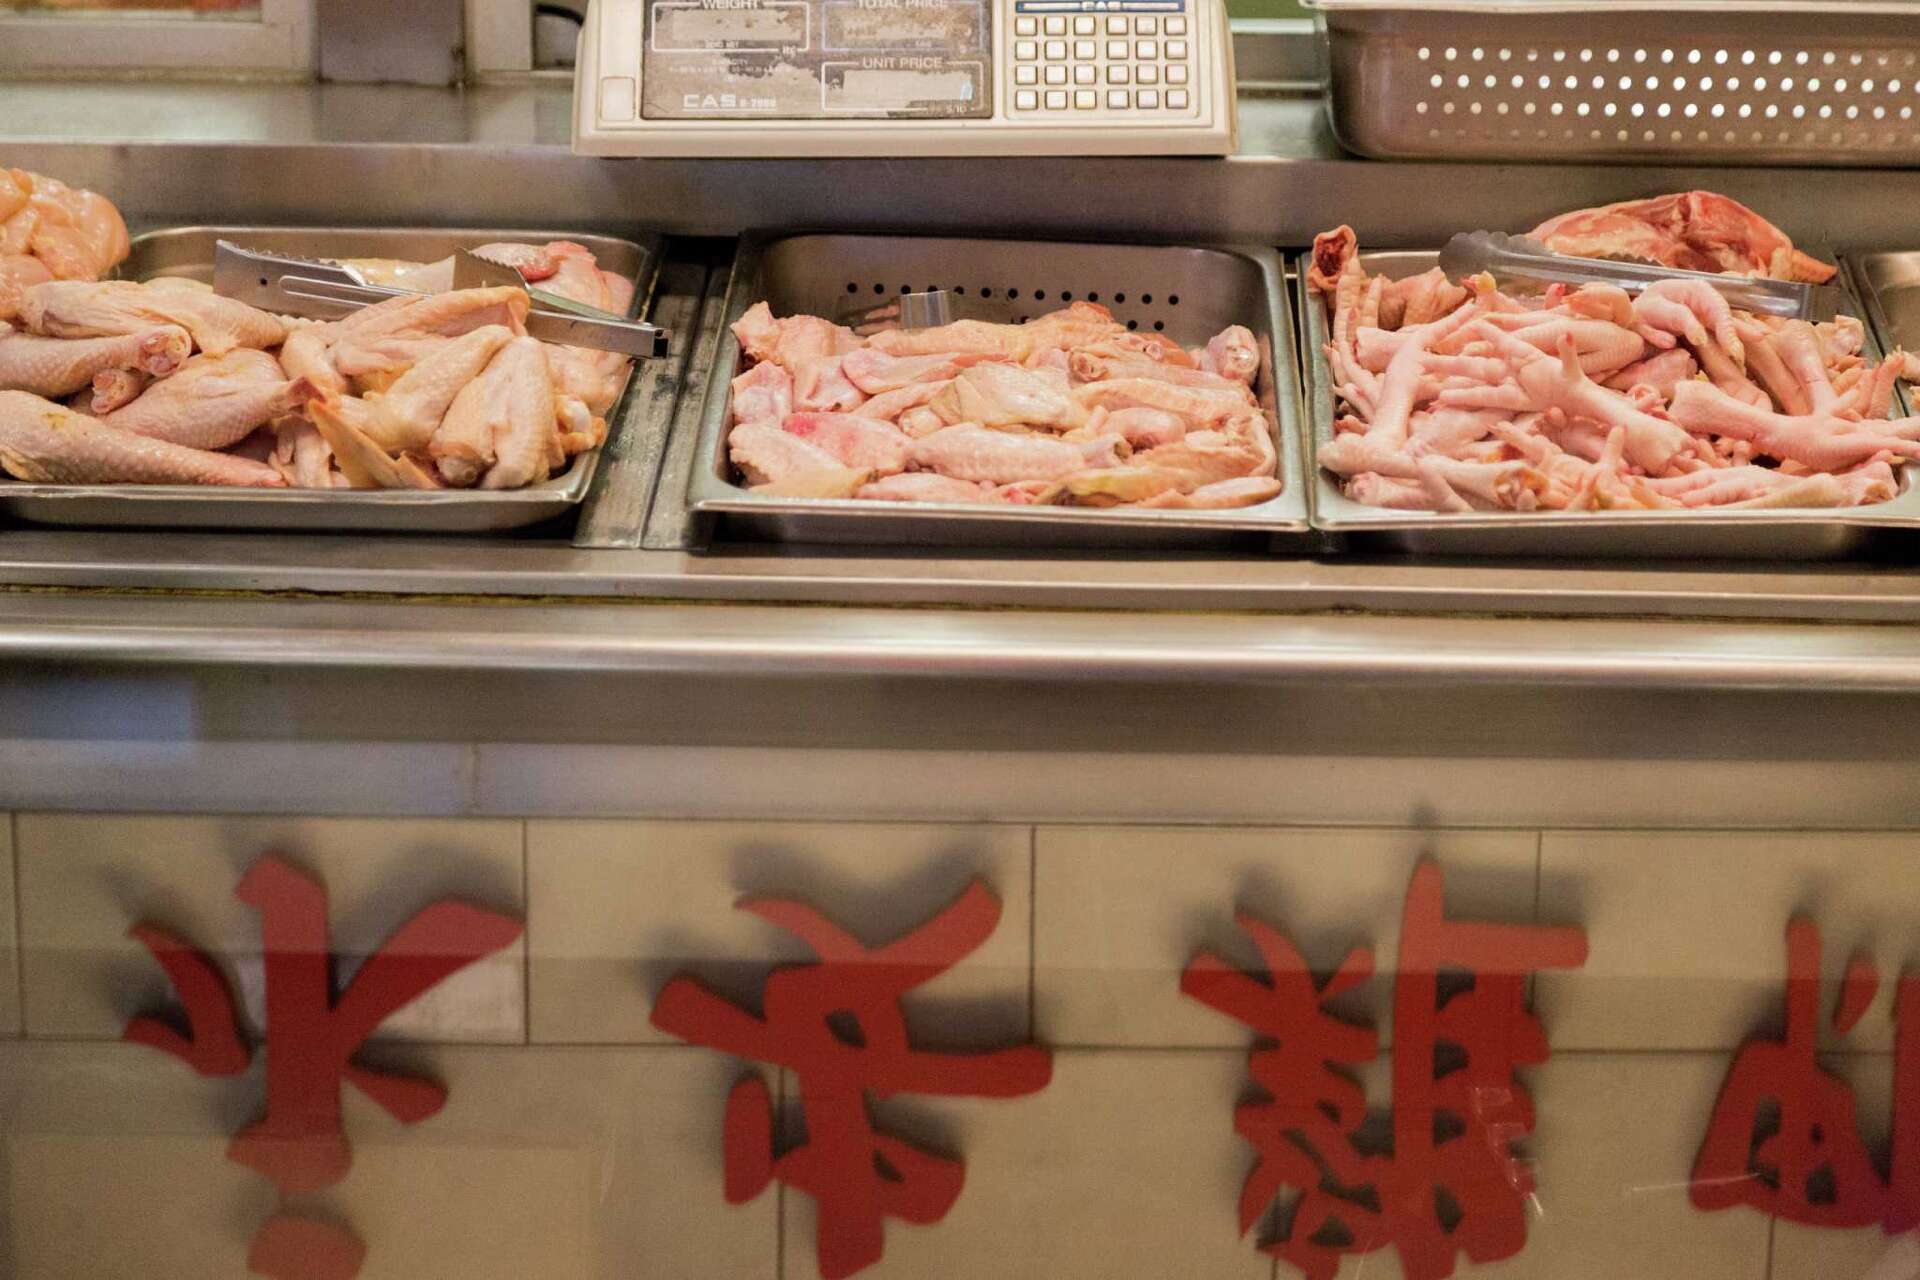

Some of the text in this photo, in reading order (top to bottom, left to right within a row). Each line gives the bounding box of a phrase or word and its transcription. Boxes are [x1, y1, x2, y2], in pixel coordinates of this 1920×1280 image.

[702, 0, 759, 9] WEIGHT
[857, 0, 948, 9] TOTAL PRICE
[863, 56, 943, 69] UNIT PRICE
[683, 94, 736, 108] CAS
